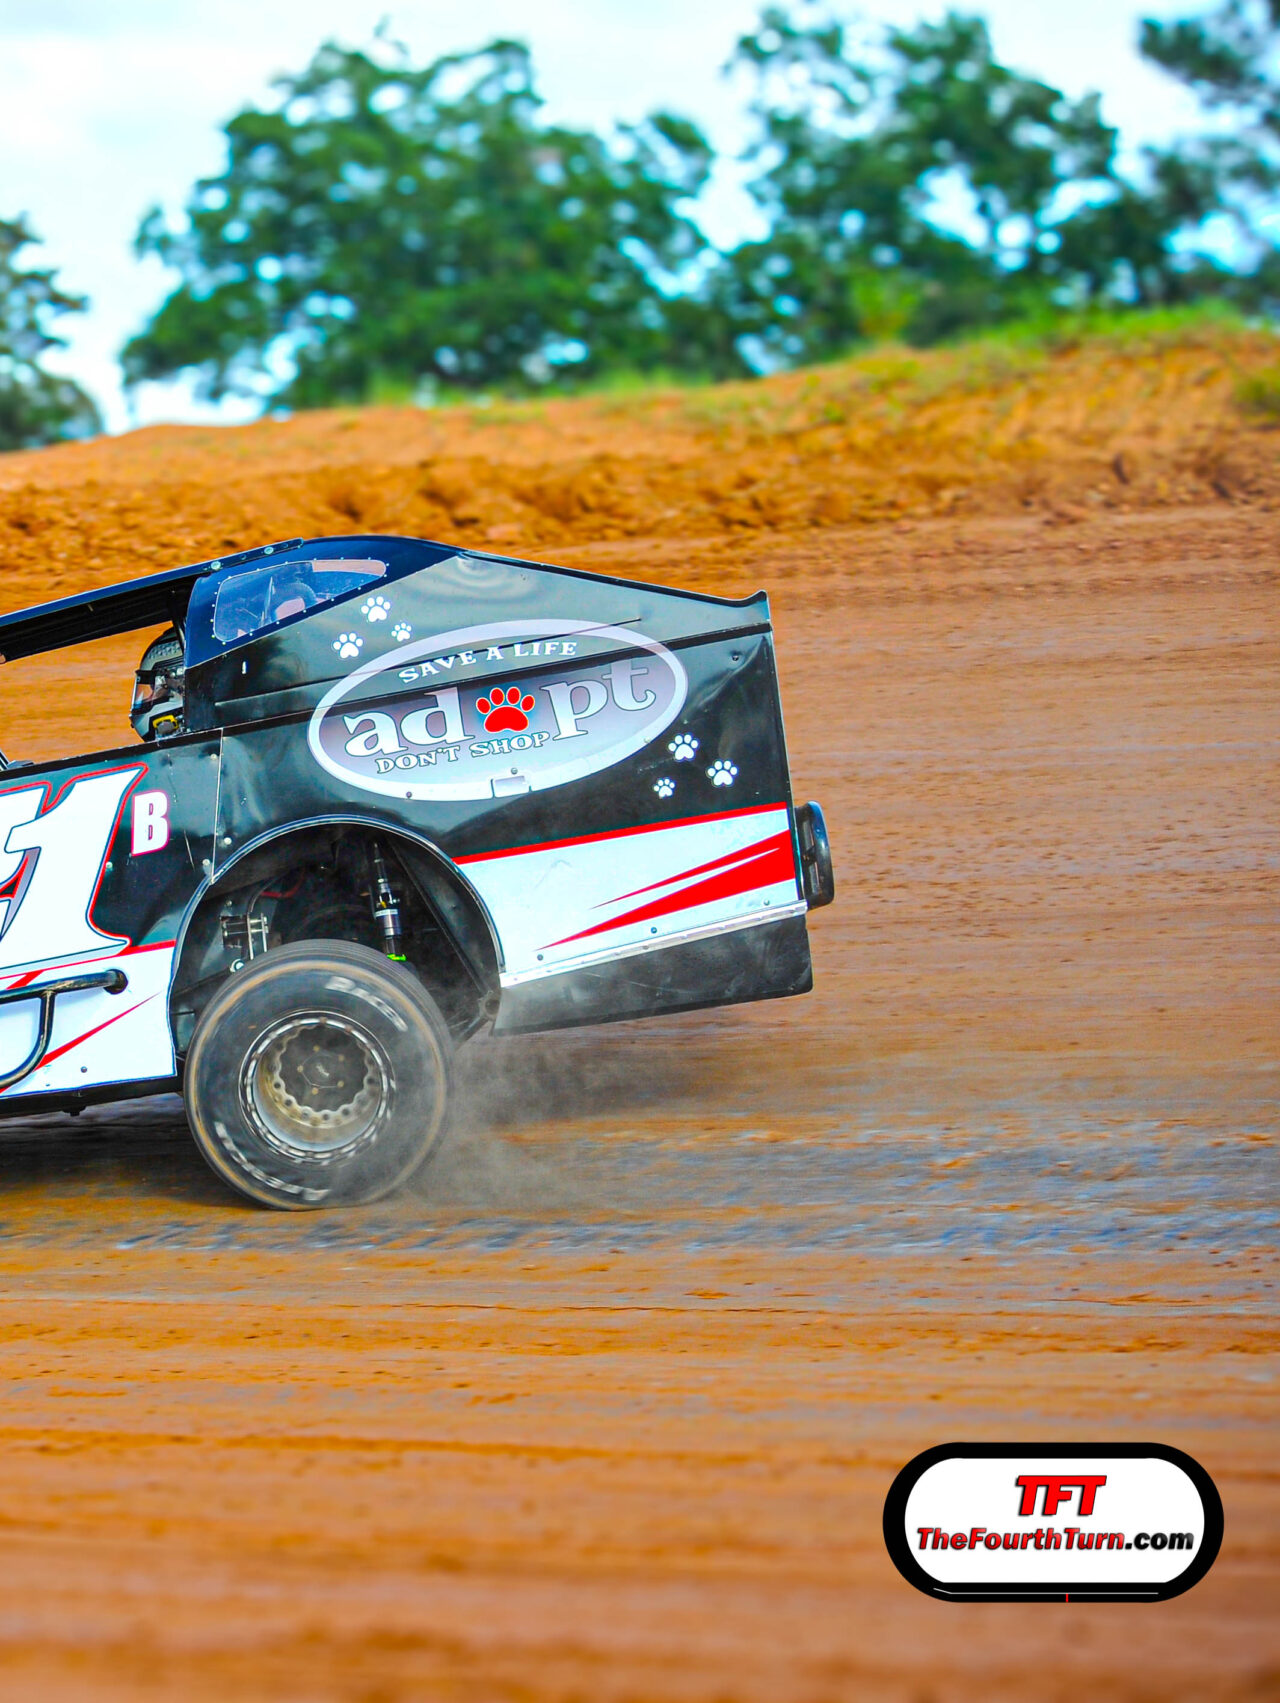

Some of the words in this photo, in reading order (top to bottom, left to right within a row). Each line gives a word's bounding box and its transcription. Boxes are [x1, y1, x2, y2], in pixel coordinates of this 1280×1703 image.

[398, 650, 476, 683] SAVE
[486, 645, 504, 661] A
[514, 641, 577, 657] LIFE
[342, 658, 657, 757] adpt
[376, 745, 461, 774] DON'T
[469, 730, 551, 758] SHOP
[131, 790, 170, 857] B
